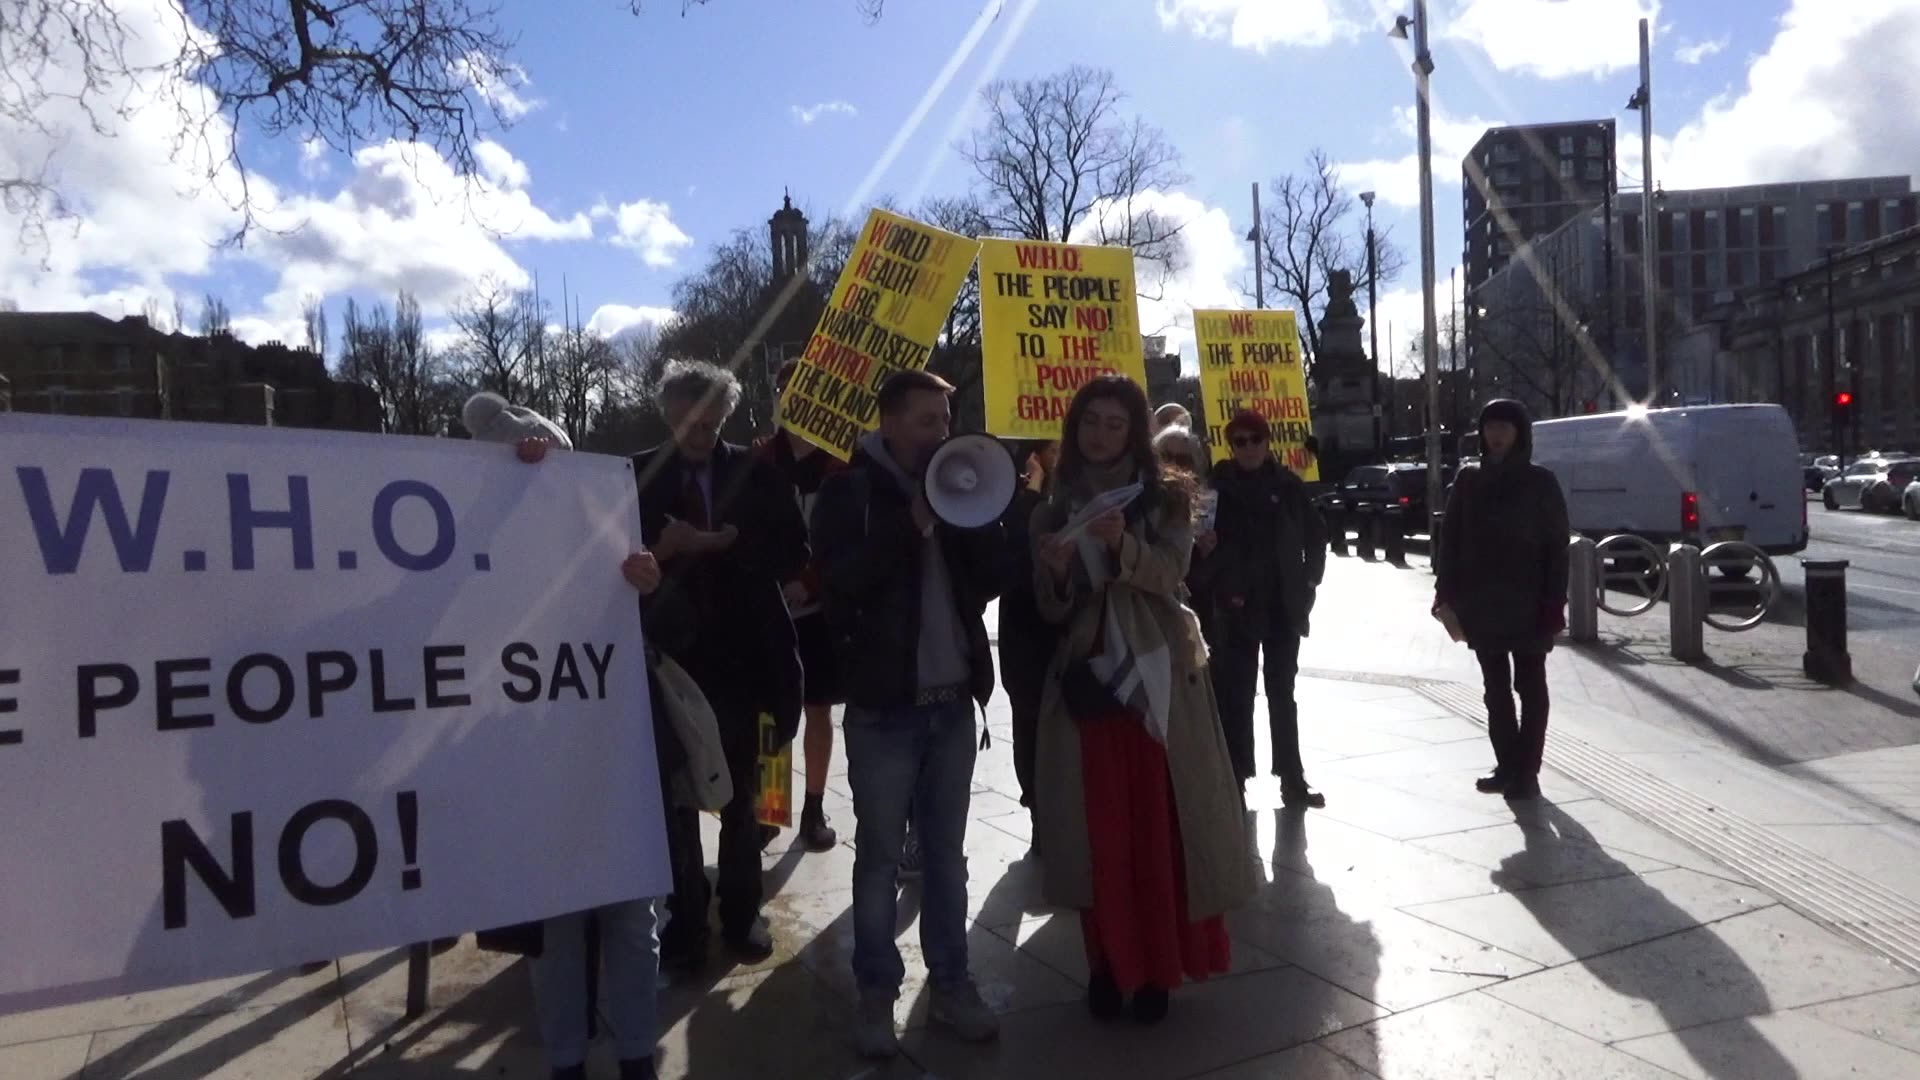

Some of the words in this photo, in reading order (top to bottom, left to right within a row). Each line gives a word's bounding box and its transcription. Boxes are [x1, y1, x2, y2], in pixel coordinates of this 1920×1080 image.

[869, 217, 930, 262] WORLD
[1016, 245, 1083, 271] W.H.O.
[855, 250, 919, 296] HEALTH
[994, 272, 1033, 298] THE
[1043, 276, 1121, 302] PEOPLE
[820, 306, 873, 346] WANT
[865, 322, 889, 357] TO
[883, 333, 930, 369] SEIZE
[1028, 304, 1068, 329] SAY
[1076, 306, 1113, 331] NO!
[1229, 314, 1254, 337] WE
[805, 334, 872, 385] CONTROL
[871, 364, 890, 393] O
[1016, 332, 1045, 358] TO
[1059, 336, 1102, 361] THE
[1206, 343, 1234, 365] THE
[1242, 343, 1295, 363] PEOPLE
[793, 361, 826, 398] THE
[819, 374, 848, 408] UK
[839, 382, 879, 424] AND
[1230, 370, 1270, 392] HOLD
[16, 466, 491, 575] W.H.O.
[77, 644, 471, 738] PEOPLE
[501, 642, 615, 702] SAY
[160, 790, 422, 930] NO!
